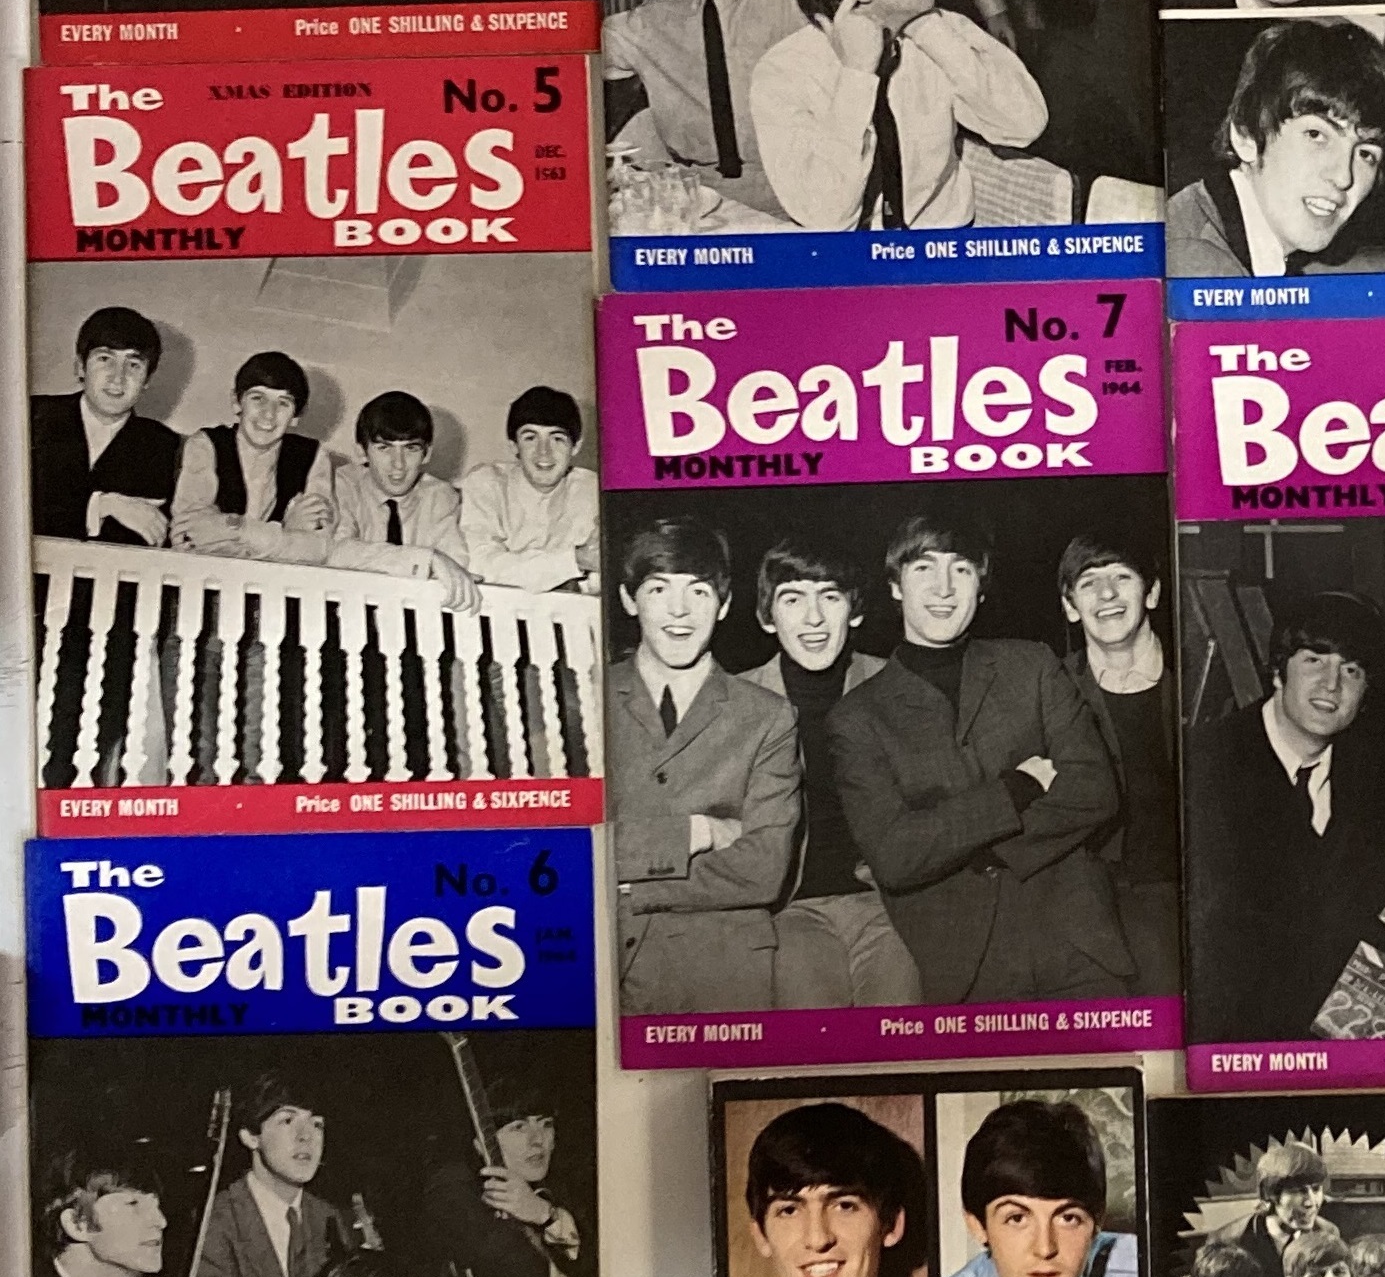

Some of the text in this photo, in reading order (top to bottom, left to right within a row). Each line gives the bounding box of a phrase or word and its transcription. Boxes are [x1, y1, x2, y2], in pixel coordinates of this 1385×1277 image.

[60, 84, 163, 111] The
[208, 83, 372, 100] XMAS EDITION
[443, 67, 561, 114] No. 5
[62, 108, 524, 227] Beatles
[333, 217, 518, 247] BOOK
[634, 314, 738, 341] The
[1005, 294, 1127, 342] No. 7
[1209, 344, 1312, 372] The
[636, 335, 1098, 457] Beatles
[910, 441, 1093, 474] BOOK
[61, 861, 165, 888] The
[63, 886, 526, 1003] Beatles
[333, 993, 519, 1025] BOOK
